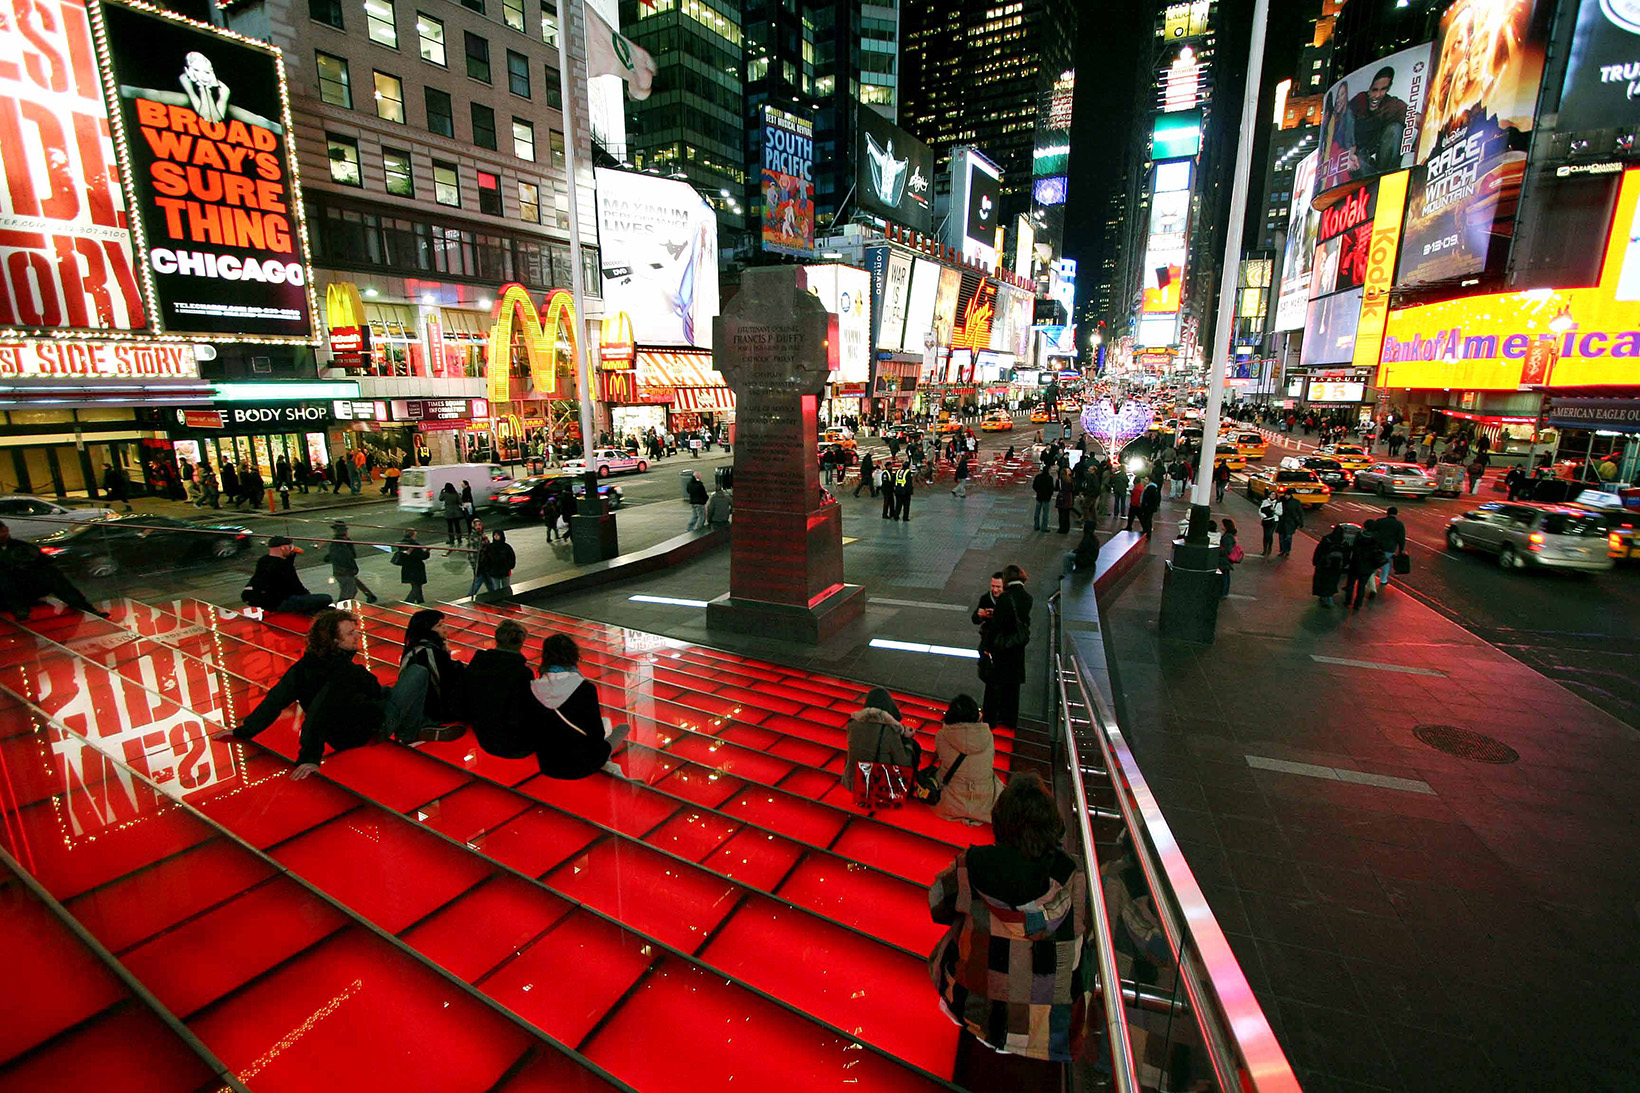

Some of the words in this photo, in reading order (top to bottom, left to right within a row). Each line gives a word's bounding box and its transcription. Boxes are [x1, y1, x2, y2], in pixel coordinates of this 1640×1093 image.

[1600, 61, 1640, 83] TRU
[766, 113, 777, 125] BEST
[777, 117, 796, 132] MUSICAL
[796, 123, 813, 138] REVIVAL
[1401, 75, 1421, 155] SOUTHPOLE
[140, 126, 282, 181] WAY'S
[765, 127, 813, 160] SOUTH
[1427, 130, 1484, 181] RACE
[765, 147, 813, 182] PACIFIC
[150, 160, 287, 214] SURE
[1422, 183, 1475, 216] MOUNTAIN
[1425, 162, 1478, 205] WITCH
[154, 196, 292, 254] THING
[604, 219, 655, 234] LIVES
[1320, 186, 1371, 240] Kodak
[150, 247, 305, 286] CHICAGO
[875, 248, 883, 295] VORNADO
[891, 264, 906, 285] WAR
[1362, 226, 1397, 318] Kodak
[733, 334, 766, 344] FRANCIS
[776, 334, 805, 343] DUFFY
[1443, 323, 1640, 360] Ameica
[36, 343, 109, 374] SIDE
[114, 344, 183, 374] STORY
[235, 408, 282, 423] BODY
[286, 406, 327, 421] SHOP
[1551, 407, 1596, 419] AMERICAN
[1596, 408, 1627, 421] EAGLE
